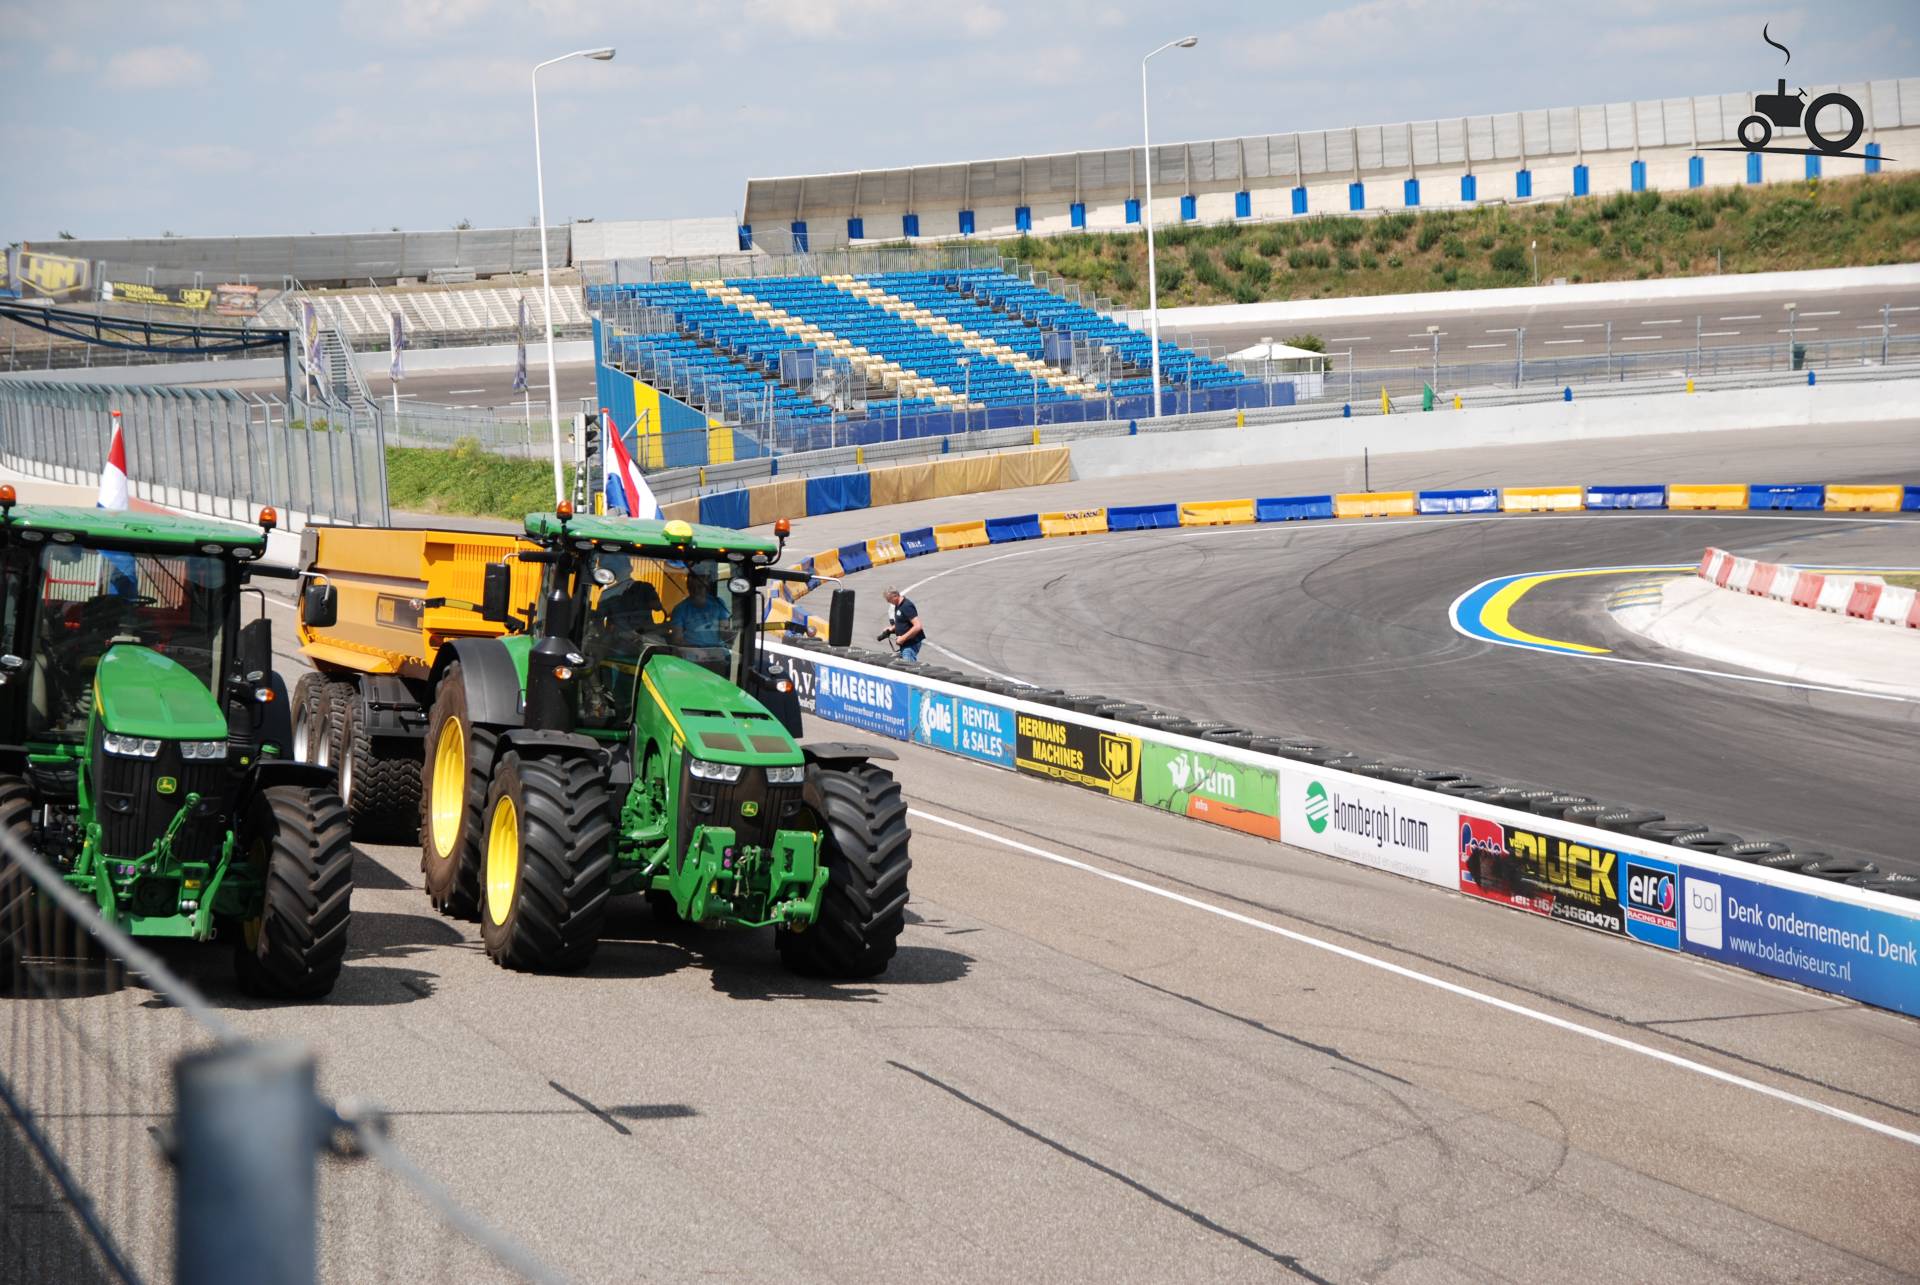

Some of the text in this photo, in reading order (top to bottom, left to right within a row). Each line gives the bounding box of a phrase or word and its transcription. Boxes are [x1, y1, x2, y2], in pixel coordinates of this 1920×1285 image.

[29, 257, 75, 289] HM
[832, 672, 893, 711] HAEGENS
[962, 705, 1003, 733] RENTAL
[1018, 715, 1067, 745] HERMANS
[962, 729, 1003, 757] & SALES
[1032, 739, 1084, 770] MACHINES
[1105, 739, 1128, 776] HM
[1195, 755, 1236, 800] bam
[1333, 792, 1429, 853] Hombergh Lomm
[1629, 875, 1658, 906] elf
[1692, 887, 1718, 914] bol
[1627, 910, 1676, 929] RACING FUEL
[1728, 896, 1918, 967] Denk ondernemend. Denk
[1729, 935, 1852, 981] www.boladviseurs.nl
